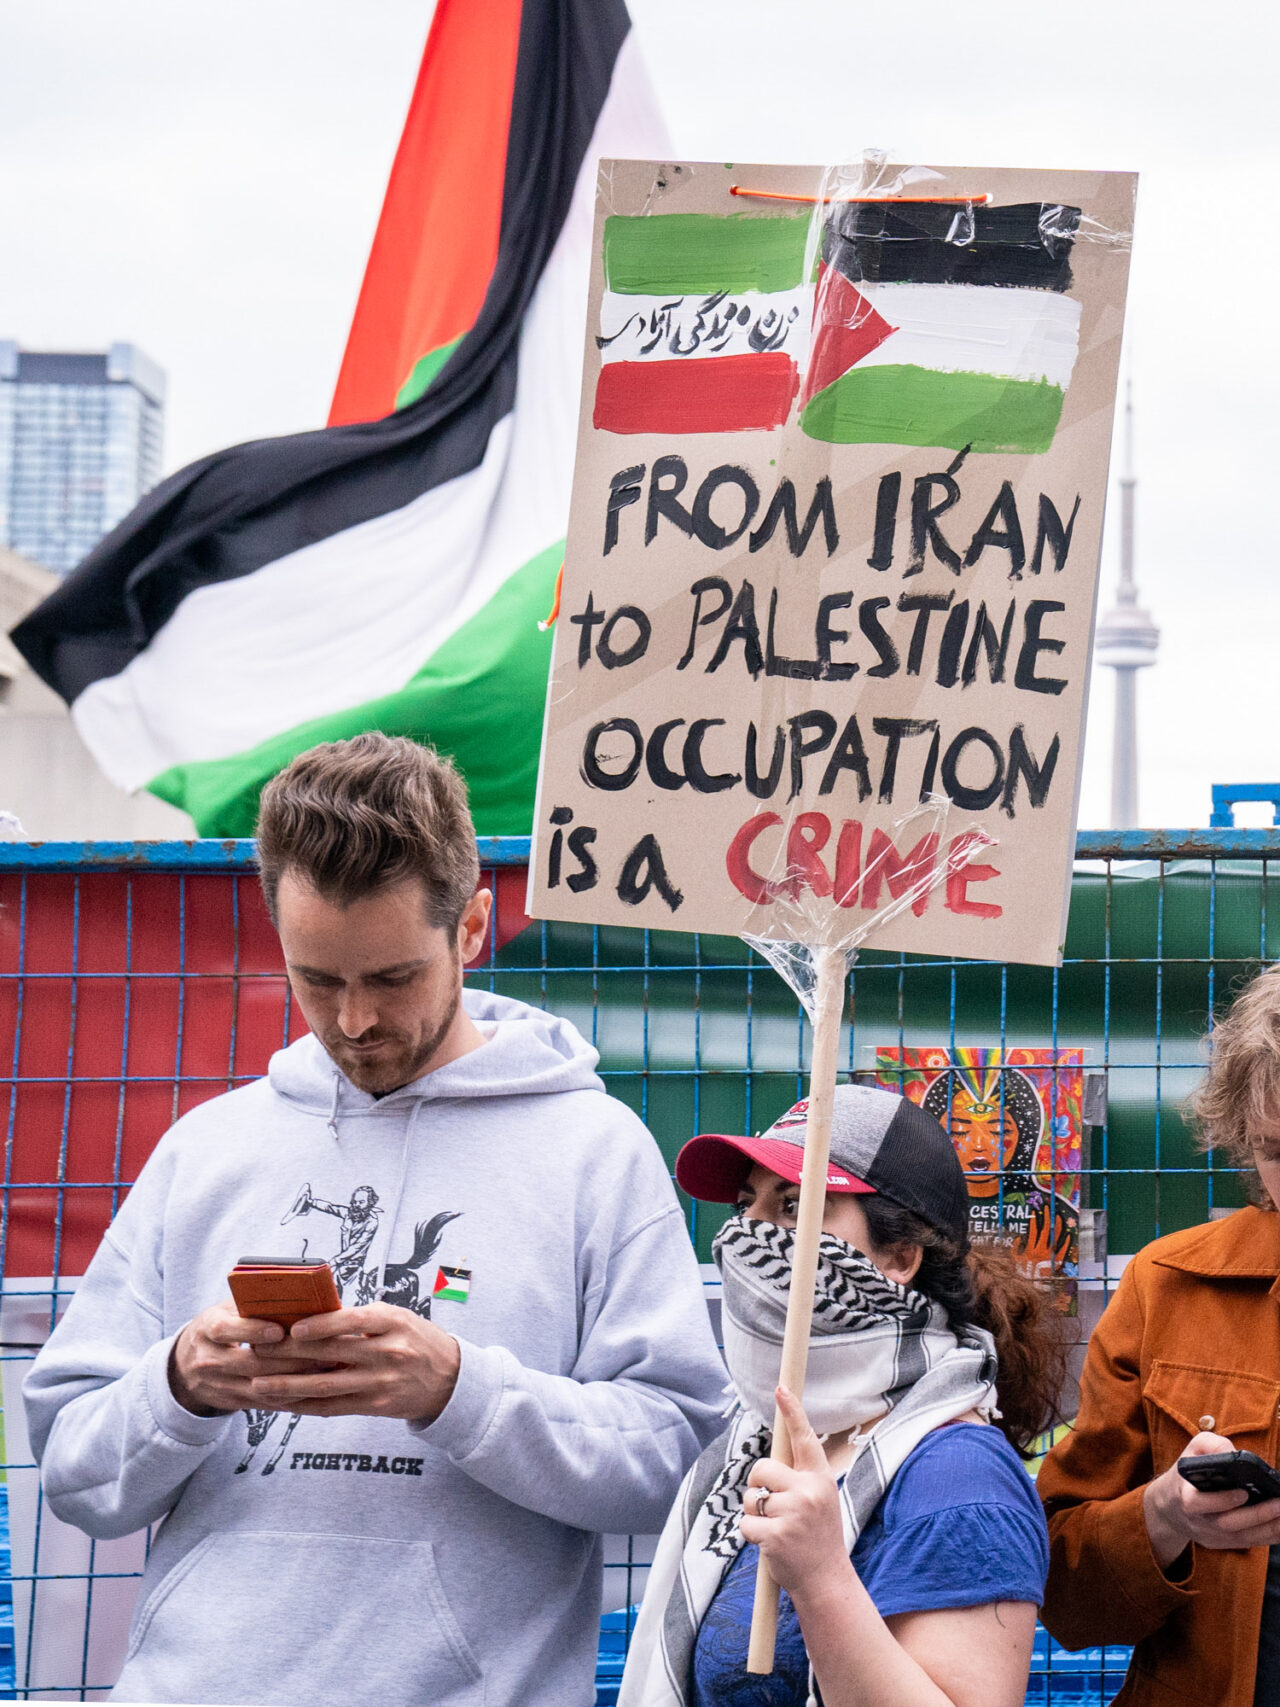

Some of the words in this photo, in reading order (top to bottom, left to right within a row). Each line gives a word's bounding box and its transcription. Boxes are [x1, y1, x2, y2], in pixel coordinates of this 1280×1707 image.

[603, 455, 840, 558] FROM
[867, 462, 1082, 579] IRAN
[570, 590, 651, 670] to
[677, 576, 1069, 695] PALESTINE
[580, 709, 1060, 818] OCCUPATION
[547, 805, 598, 893] is
[615, 833, 684, 912] a
[726, 810, 1003, 919] CRIME
[969, 1204, 1036, 1220] CESRAL
[1009, 1222, 1029, 1234] ME
[289, 1452, 424, 1476] FIGHTBACK
